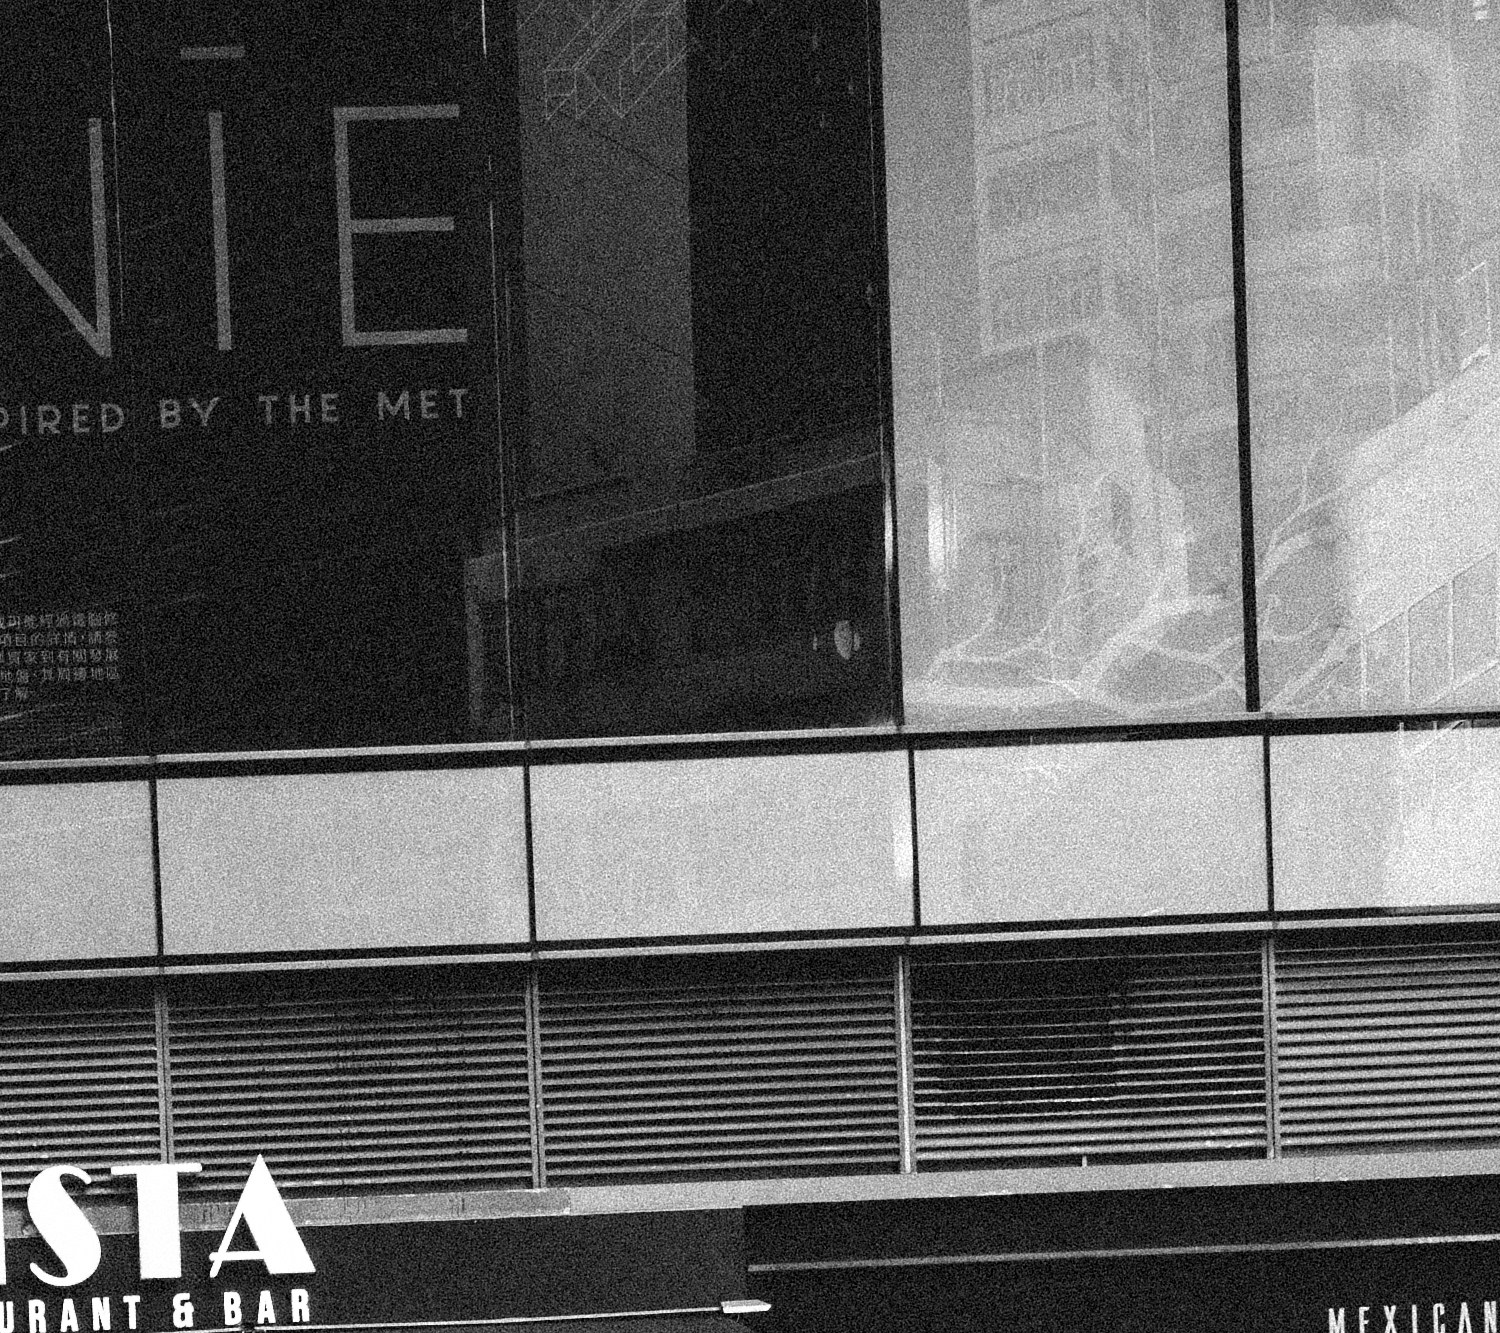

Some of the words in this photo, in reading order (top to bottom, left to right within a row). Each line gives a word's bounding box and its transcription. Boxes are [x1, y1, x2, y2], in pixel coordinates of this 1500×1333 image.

[159, 396, 219, 430] BY
[257, 392, 339, 425] THE
[376, 388, 468, 420] MET
[173, 1293, 195, 1328] &
[224, 1288, 312, 1324] BAR
